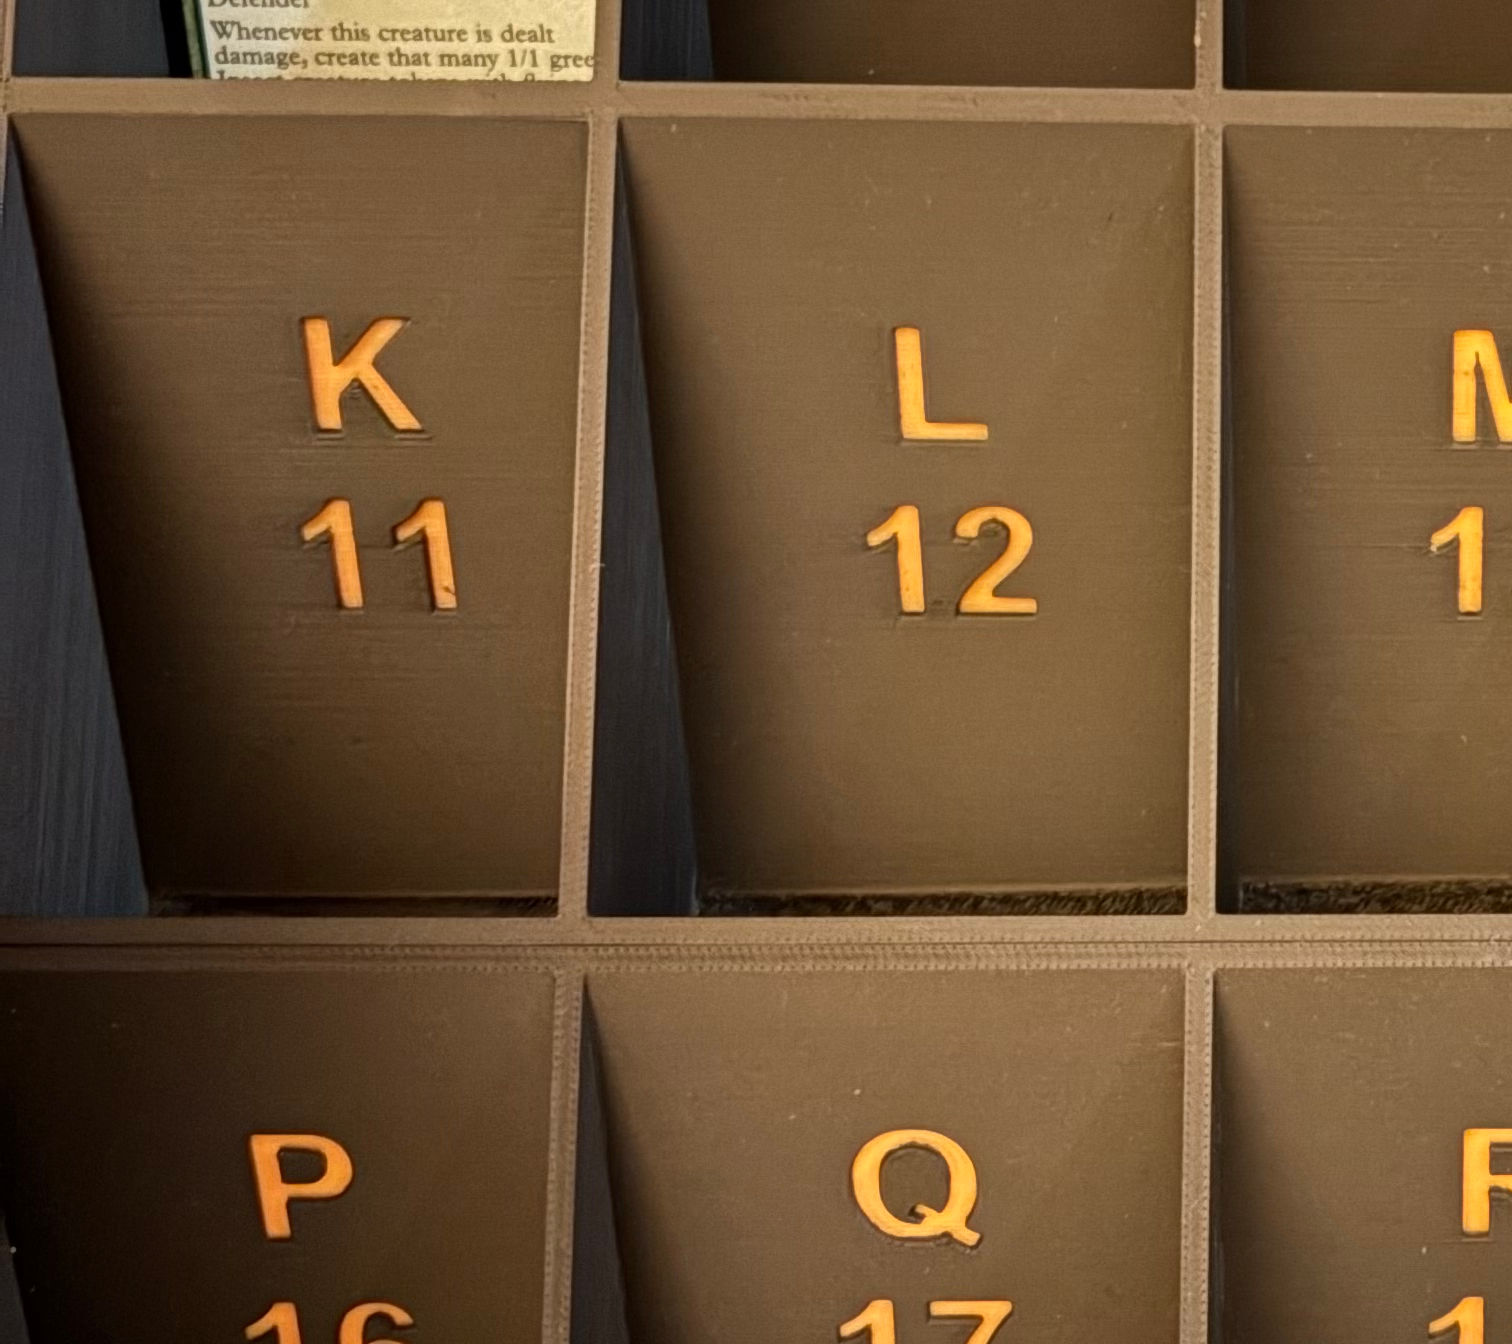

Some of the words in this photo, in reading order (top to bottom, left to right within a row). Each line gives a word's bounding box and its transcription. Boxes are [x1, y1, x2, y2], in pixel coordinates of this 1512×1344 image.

[209, 20, 321, 42] Whenever
[331, 22, 370, 42] this
[377, 23, 469, 43] creature
[476, 23, 493, 43] is
[500, 23, 555, 44] dealt
[214, 46, 307, 70] damage,
[314, 50, 379, 67] create
[388, 48, 431, 68] that
[438, 52, 498, 75] many
[508, 49, 539, 69] 1/1
[303, 317, 425, 432] K
[894, 326, 991, 442] L
[301, 499, 459, 610] 11
[865, 503, 1040, 616] 12
[250, 1133, 353, 1239] P
[850, 1127, 983, 1248] Q
